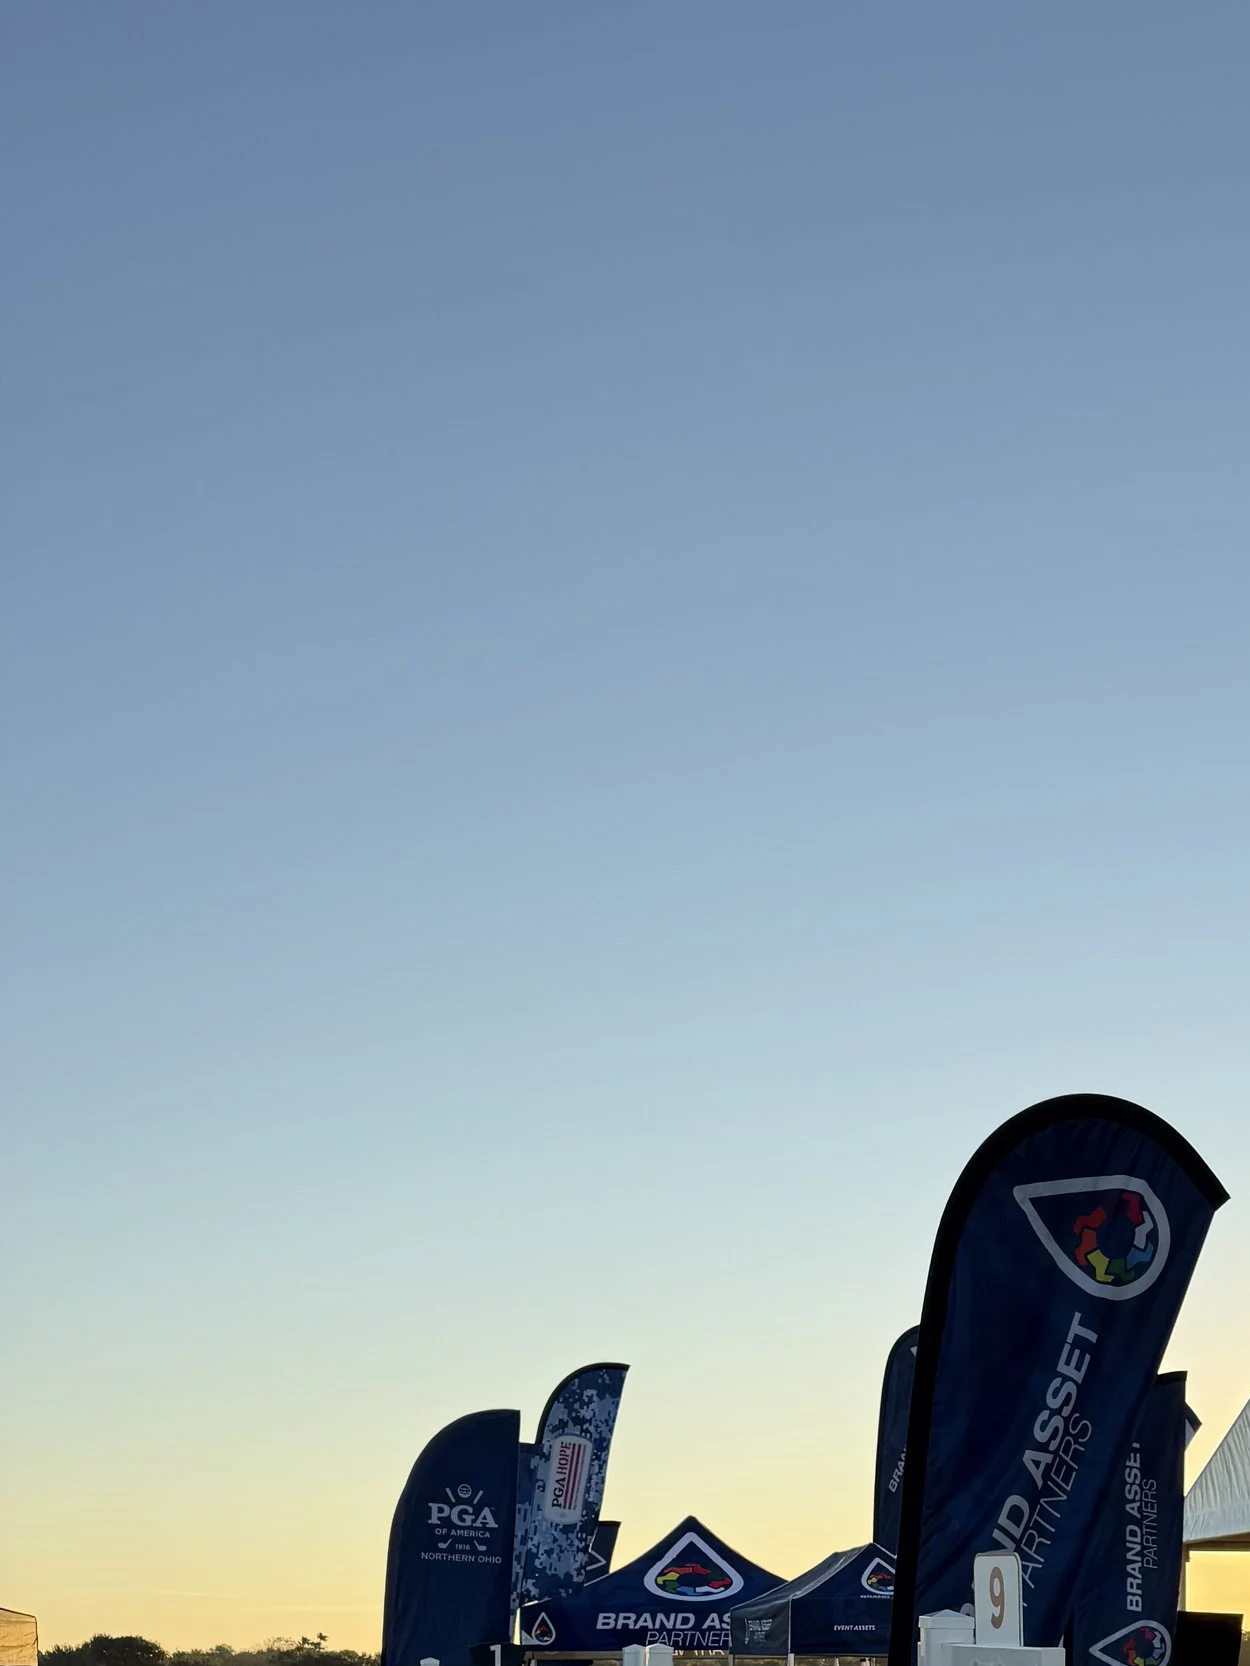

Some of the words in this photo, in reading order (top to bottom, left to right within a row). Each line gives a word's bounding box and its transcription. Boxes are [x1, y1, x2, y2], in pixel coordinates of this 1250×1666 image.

[1022, 1311, 1098, 1488] ASSET
[556, 1441, 572, 1475] HOPE
[552, 1476, 566, 1508] PGA
[427, 1503, 498, 1528] PGA
[1021, 1413, 1092, 1607] ARTNERS
[1142, 1479, 1158, 1569] PARTNERS
[450, 1529, 490, 1538] AMERICA
[420, 1552, 475, 1562] NORTHERN
[478, 1555, 502, 1564] OHIO
[1126, 1525, 1142, 1612] BRAND
[989, 1566, 1005, 1630] 9
[596, 1613, 695, 1630] BRAND
[646, 1631, 732, 1647] PARTNER
